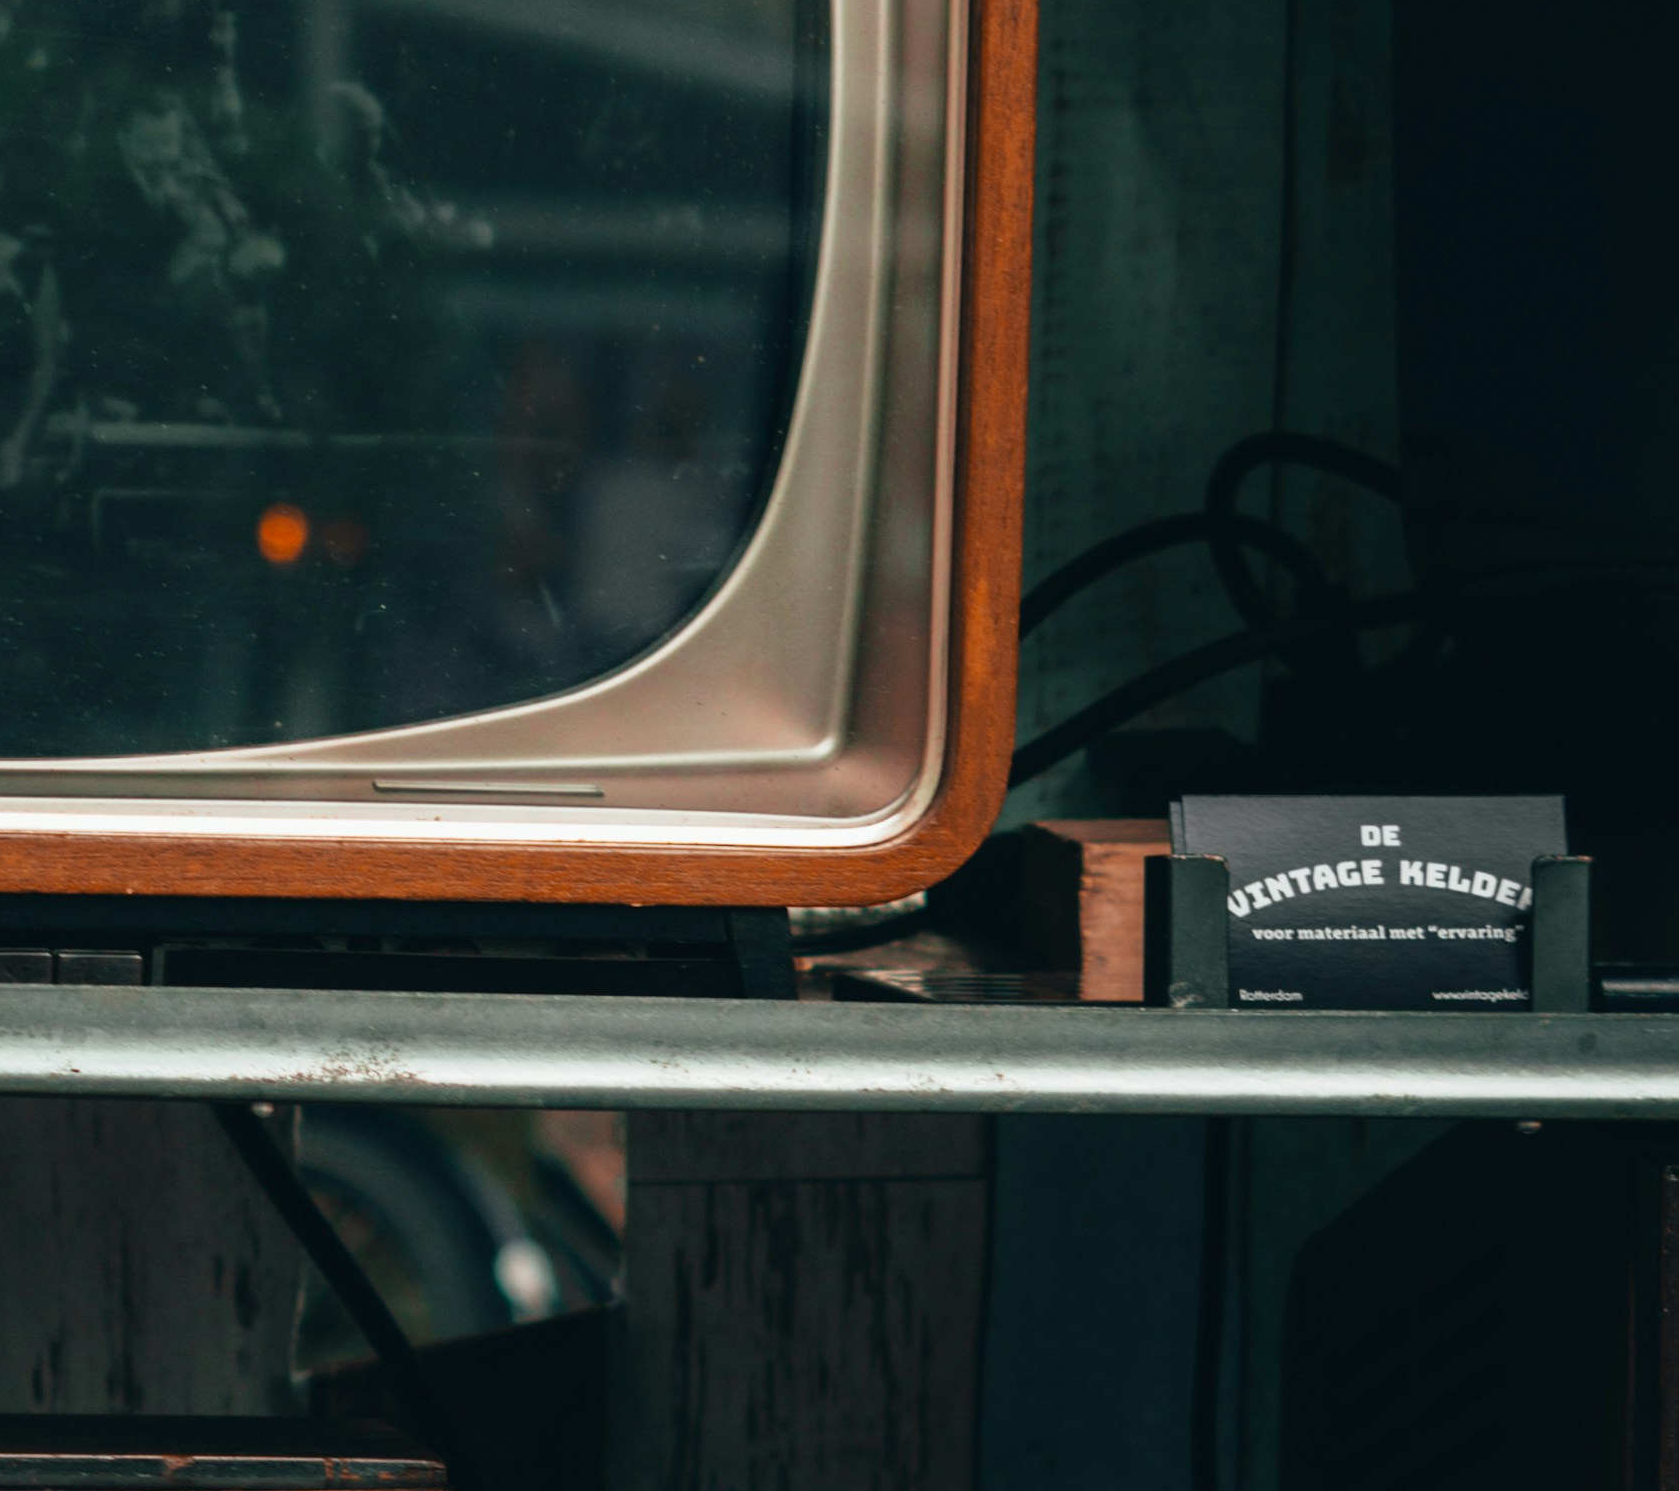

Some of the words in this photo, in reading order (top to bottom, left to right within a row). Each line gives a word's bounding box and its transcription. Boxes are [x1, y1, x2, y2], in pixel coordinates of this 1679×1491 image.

[1360, 824, 1402, 847] DE
[1227, 859, 1385, 918] VINTAGE
[1251, 928, 1295, 940] voor
[1296, 925, 1387, 940] materiaal
[1388, 926, 1425, 940] met
[1239, 988, 1303, 1002] Rotterdam
